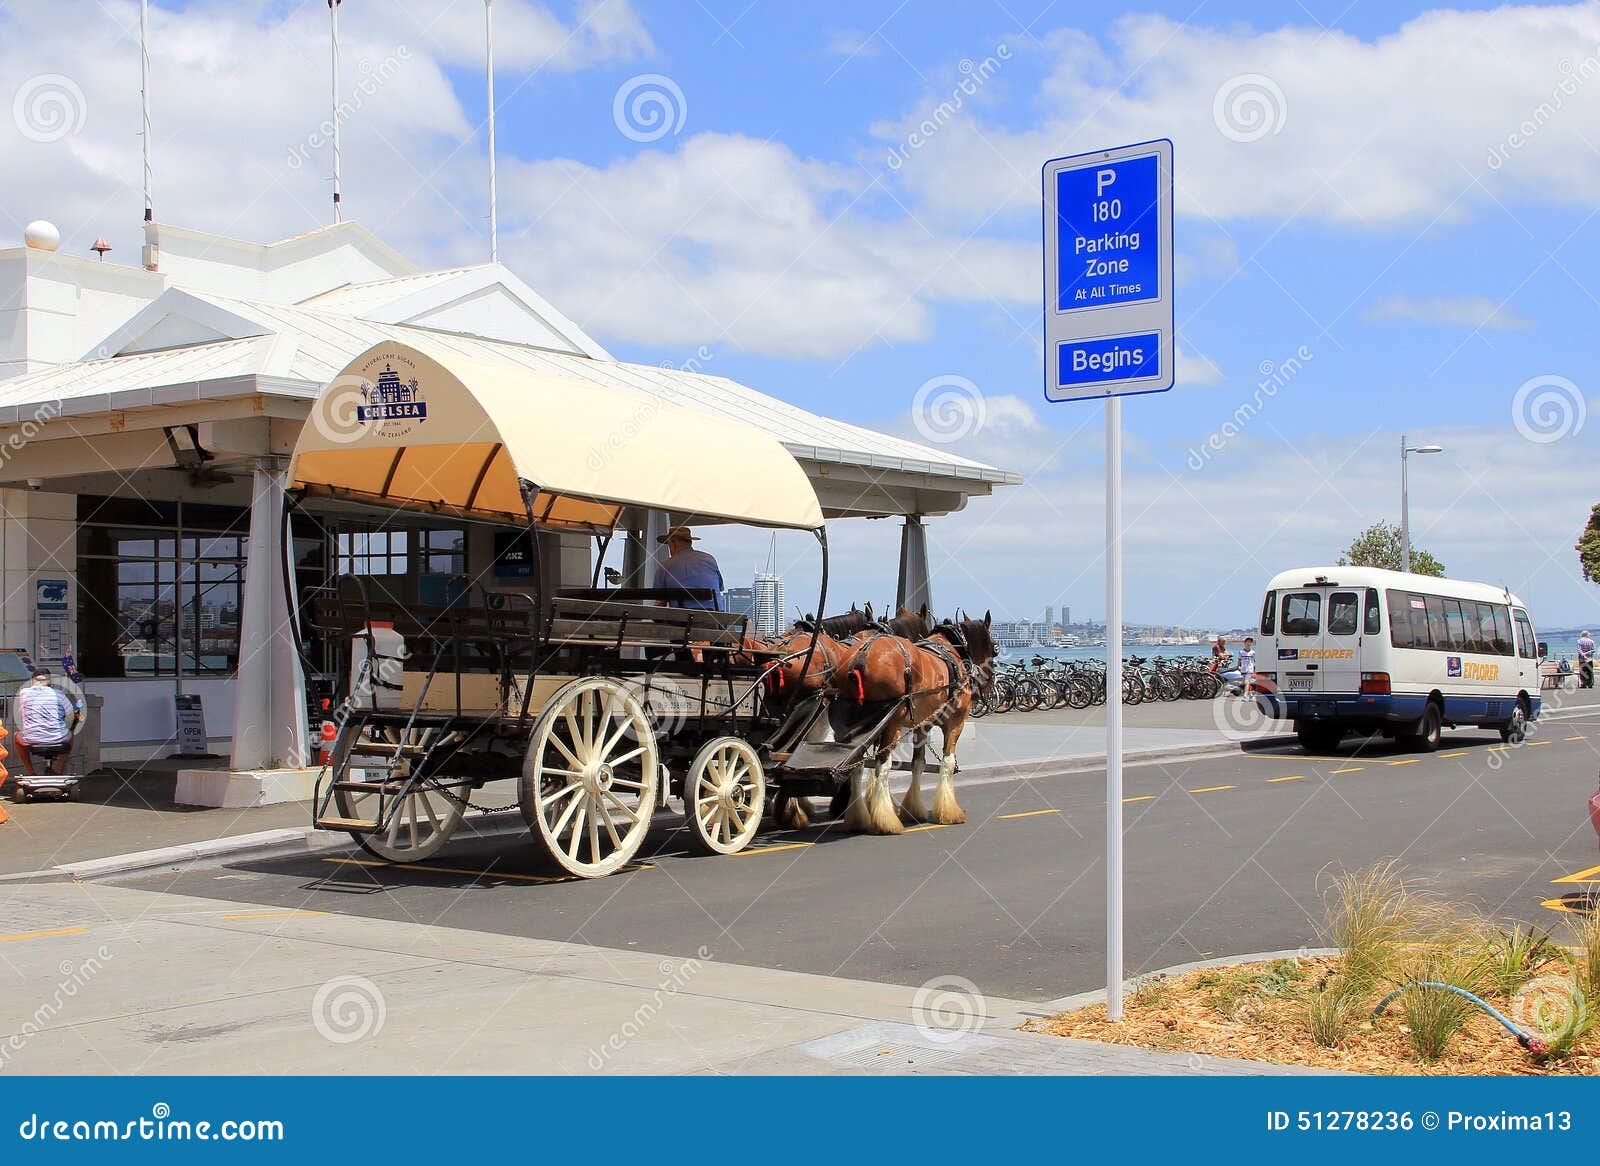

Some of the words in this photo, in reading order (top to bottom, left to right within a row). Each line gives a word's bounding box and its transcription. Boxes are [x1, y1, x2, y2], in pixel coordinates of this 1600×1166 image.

[1096, 169, 1117, 197] P
[1092, 199, 1121, 223] 180
[1075, 231, 1140, 254] Parking
[1086, 258, 1129, 277] Zone
[1075, 288, 1087, 300] At
[1090, 285, 1105, 298] All
[1109, 282, 1141, 296] Times
[1072, 346, 1144, 373] Begins
[364, 405, 420, 418] CHELSEA
[388, 427, 412, 438] ZEALAND
[504, 551, 523, 560] ANZ
[1299, 648, 1354, 659] EXPLORER
[1463, 661, 1499, 681] EXPLORER
[184, 728, 202, 737] OPEN
